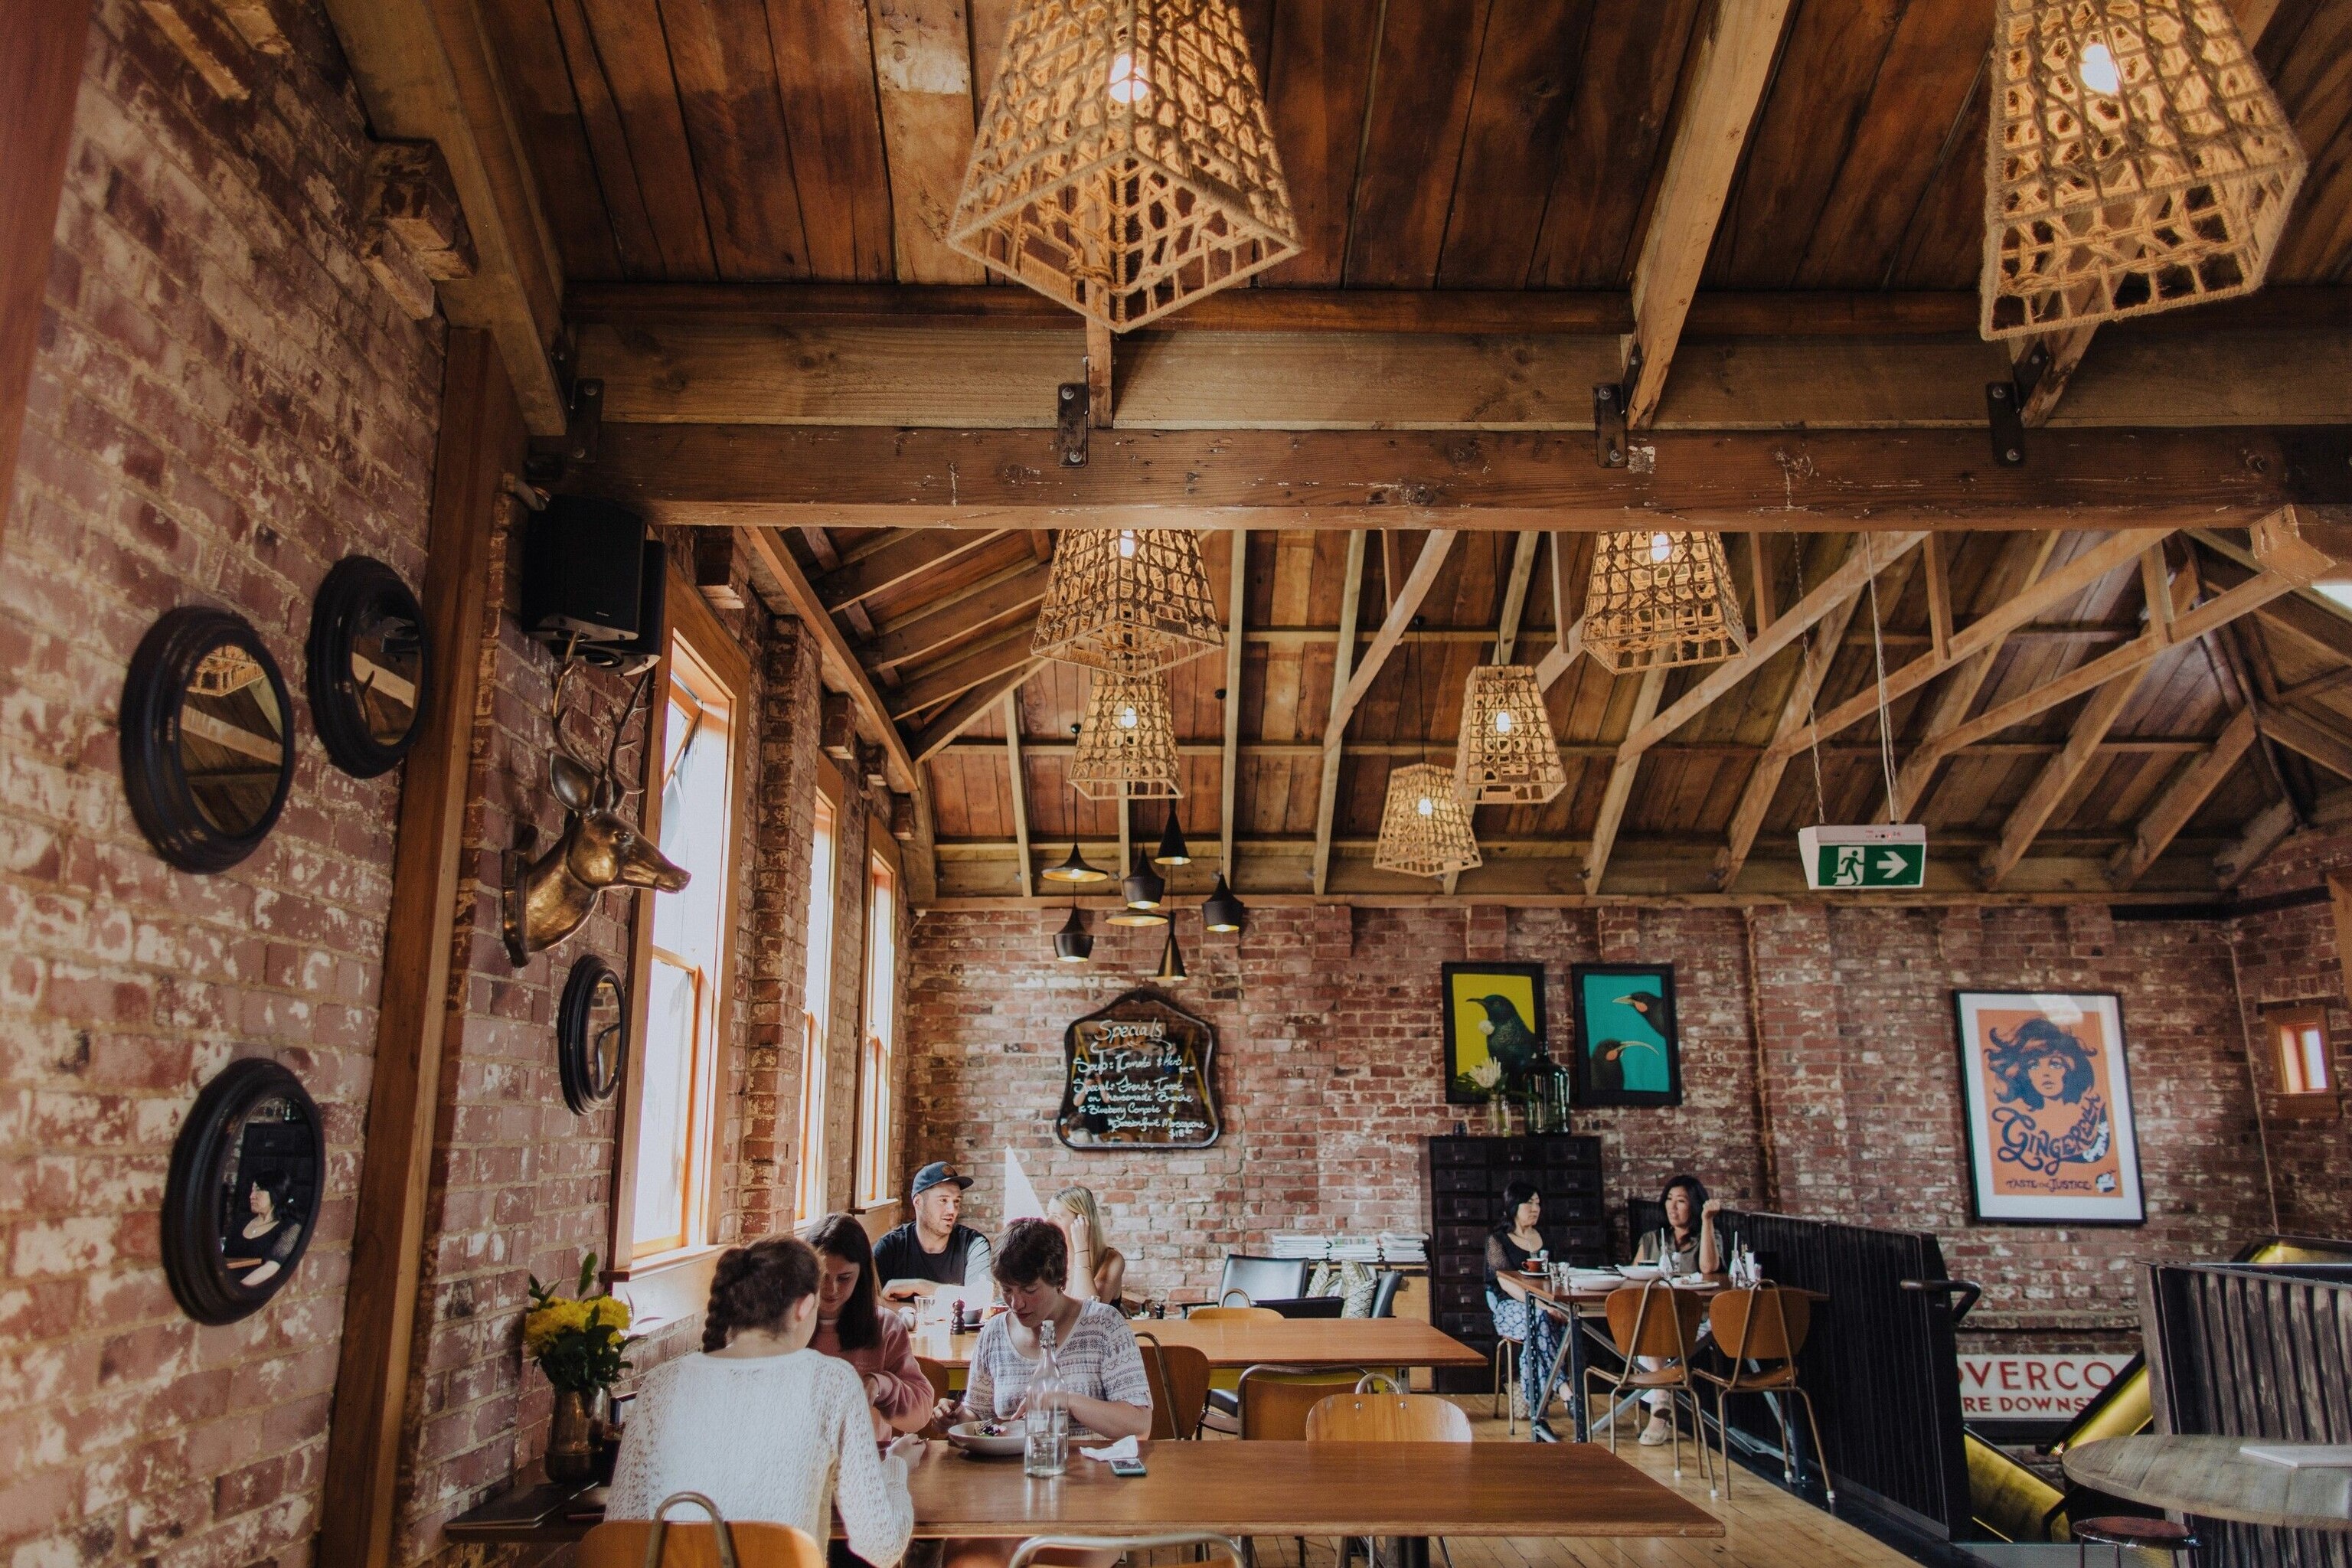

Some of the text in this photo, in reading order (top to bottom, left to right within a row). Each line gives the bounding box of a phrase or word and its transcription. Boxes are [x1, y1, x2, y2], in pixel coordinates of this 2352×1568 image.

[1094, 1018, 1162, 1044] Specials
[2006, 1179, 2037, 1189] TASTE
[2049, 1178, 2092, 1192] JUSTICE
